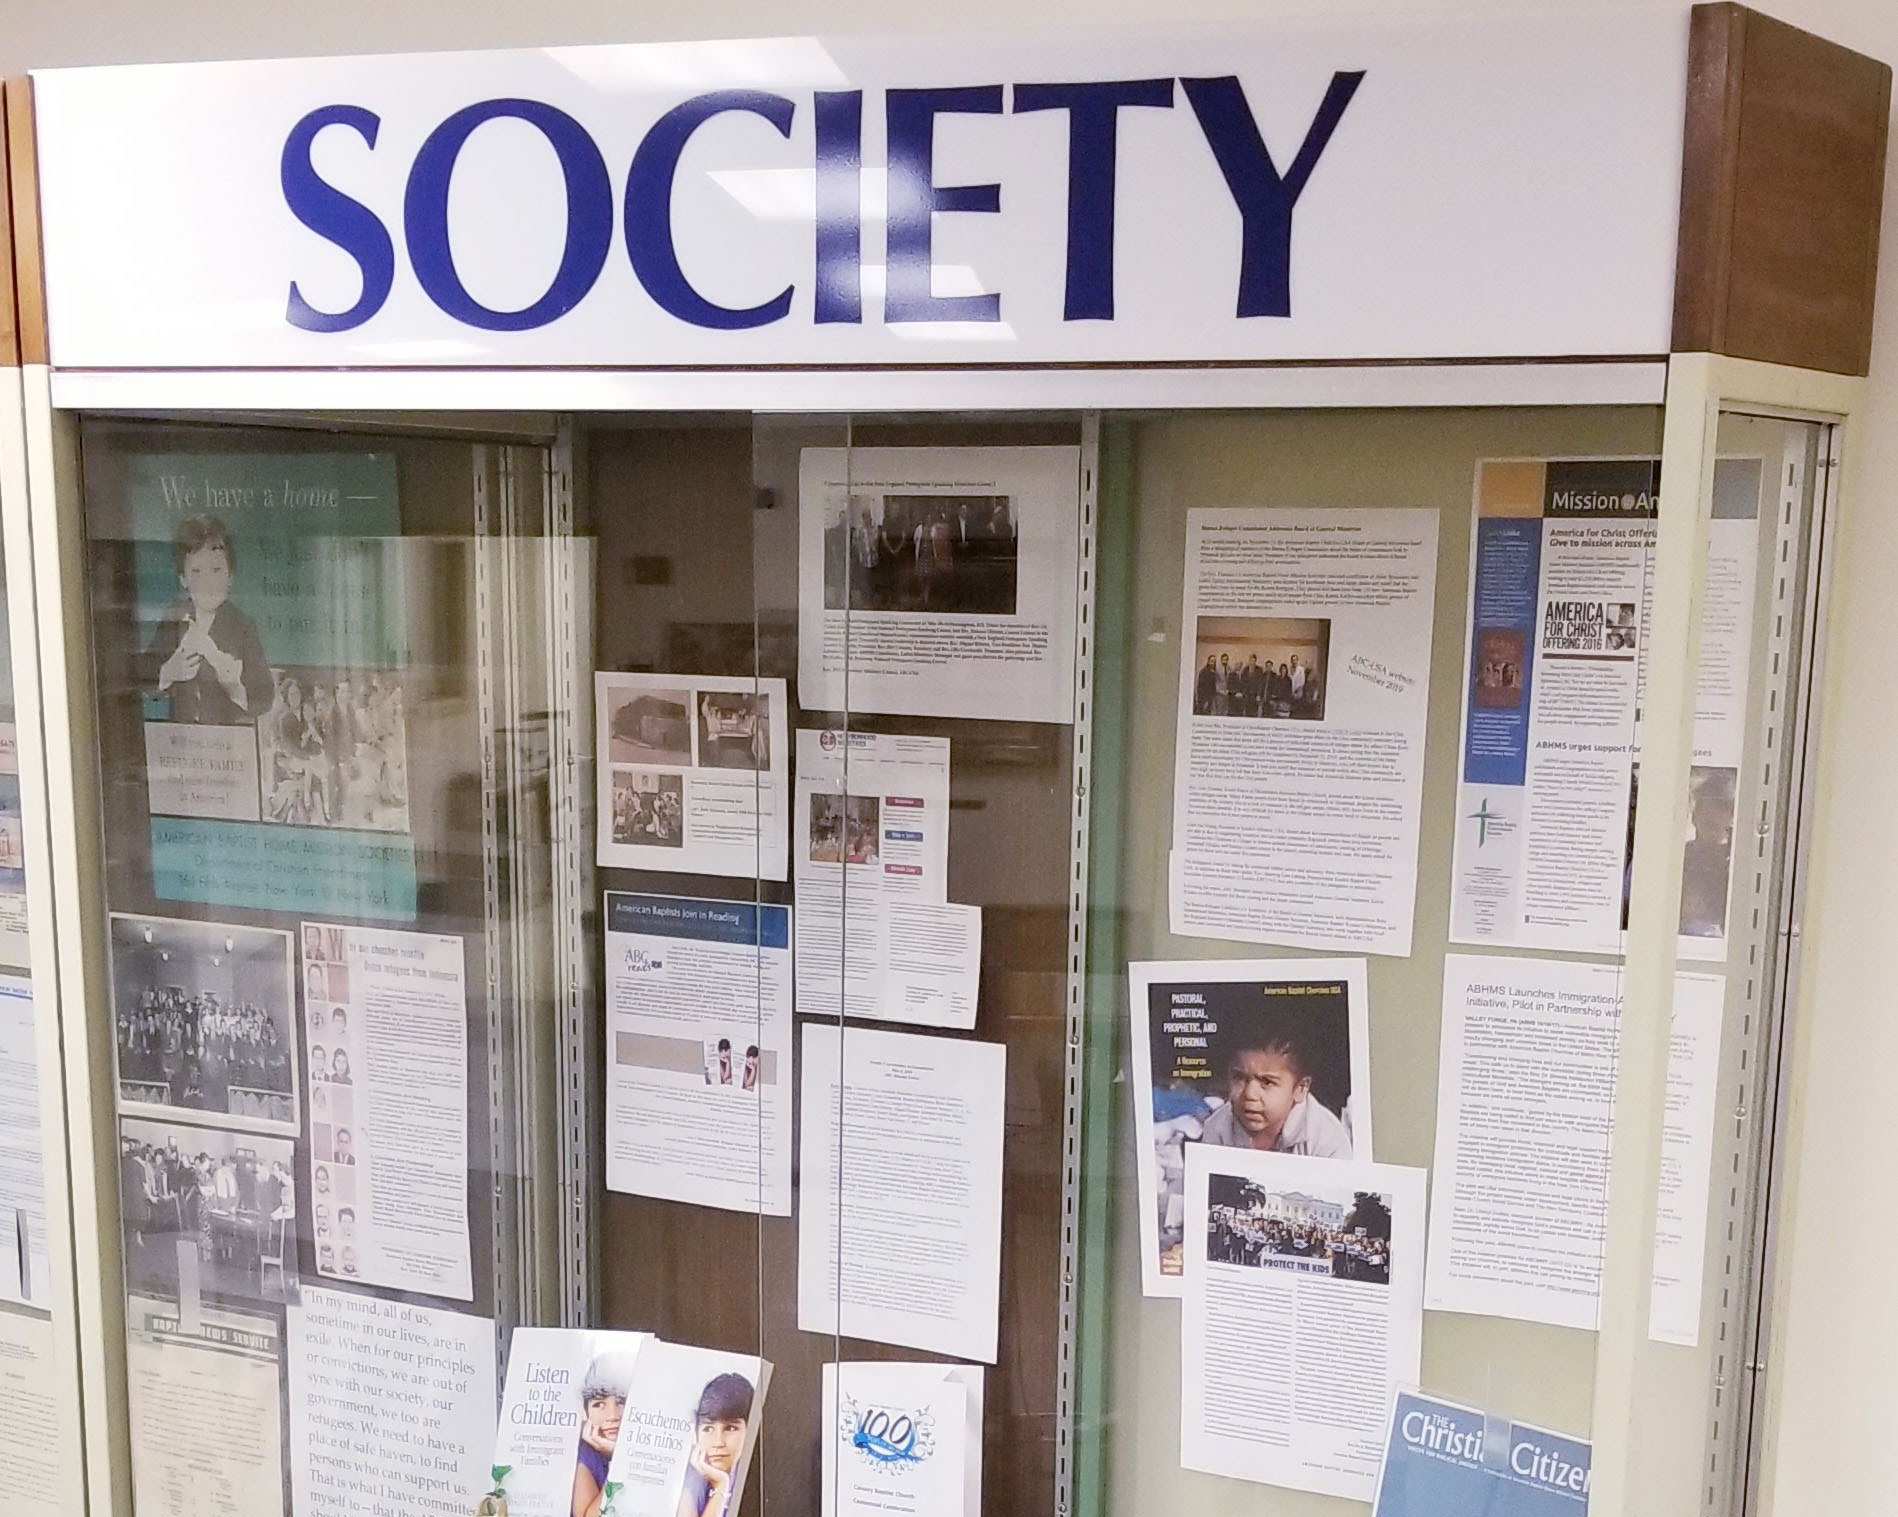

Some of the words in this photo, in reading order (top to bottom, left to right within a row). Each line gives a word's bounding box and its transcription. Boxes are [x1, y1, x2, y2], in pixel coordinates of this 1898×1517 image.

[280, 70, 1367, 332] SOCIETY
[160, 476, 196, 509] We
[205, 479, 253, 508] have
[263, 489, 273, 506] a
[284, 480, 340, 508] home
[1552, 491, 1619, 510] Mission
[1550, 529, 1584, 537] America
[1587, 528, 1599, 537] for
[1601, 529, 1626, 537] Christ
[1546, 602, 1603, 621] AMERICA
[1544, 623, 1564, 637] FOR
[1567, 623, 1603, 638] CHRIST
[1543, 637, 1580, 649] OFFERING
[1582, 638, 1602, 650] 2016
[1347, 665, 1384, 686] November
[1536, 741, 1567, 750] ABHMS
[1569, 744, 1591, 753] urges
[1594, 744, 1626, 754] support
[1629, 745, 1641, 753] for
[616, 904, 651, 914] American
[653, 906, 680, 918] Baptists
[682, 910, 697, 919] Join
[699, 911, 706, 919] in
[709, 912, 740, 925] Reading
[624, 949, 648, 963] ABC
[1466, 984, 1505, 995] ABHMS
[1509, 987, 1555, 999] Launches
[1466, 998, 1508, 1009] Initiative,
[1512, 1000, 1533, 1010] Pilot
[1536, 1003, 1544, 1011] in
[1547, 1003, 1601, 1017] Partnership
[1174, 1037, 1208, 1048] PERSONAL
[1264, 1259, 1295, 1269] PROTECT
[1297, 1262, 1310, 1271] THE
[1313, 1264, 1329, 1273] KIDS
[326, 1295, 342, 1310] my
[347, 1300, 380, 1316] mind,
[384, 1305, 397, 1319] all
[401, 1310, 412, 1321] of
[416, 1314, 431, 1326] us,
[306, 1313, 358, 1331] sometime
[363, 1322, 373, 1334] in
[377, 1327, 397, 1339] our
[400, 1328, 430, 1346] lives,
[434, 1339, 451, 1349] are
[455, 1340, 466, 1352] in
[339, 1336, 371, 1353] When
[374, 1344, 390, 1358] for
[393, 1352, 413, 1362] our
[418, 1354, 475, 1375] principles
[526, 1362, 569, 1384] Listen
[529, 1388, 540, 1401] to
[544, 1386, 561, 1402] the
[511, 1404, 577, 1427] Children
[628, 1407, 691, 1432] Escuchemos
[1432, 1414, 1448, 1428] THE
[307, 1411, 358, 1431] refugees.
[361, 1421, 379, 1435] We
[383, 1428, 408, 1442] need
[413, 1434, 424, 1445] to
[427, 1435, 455, 1451] have
[458, 1445, 464, 1454] a
[861, 1409, 912, 1444] 100
[627, 1433, 633, 1442] a
[636, 1429, 651, 1444] los
[654, 1432, 683, 1451] niños
[309, 1453, 351, 1470] persons
[354, 1461, 379, 1476] who
[382, 1469, 401, 1480] can
[405, 1474, 449, 1492] support
[454, 1485, 470, 1495] us.
[310, 1469, 334, 1483] That
[337, 1475, 346, 1486] is
[349, 1479, 376, 1495] what
[381, 1485, 385, 1496] I
[388, 1487, 415, 1504] have
[310, 1491, 347, 1509] myself
[349, 1499, 360, 1511] to
